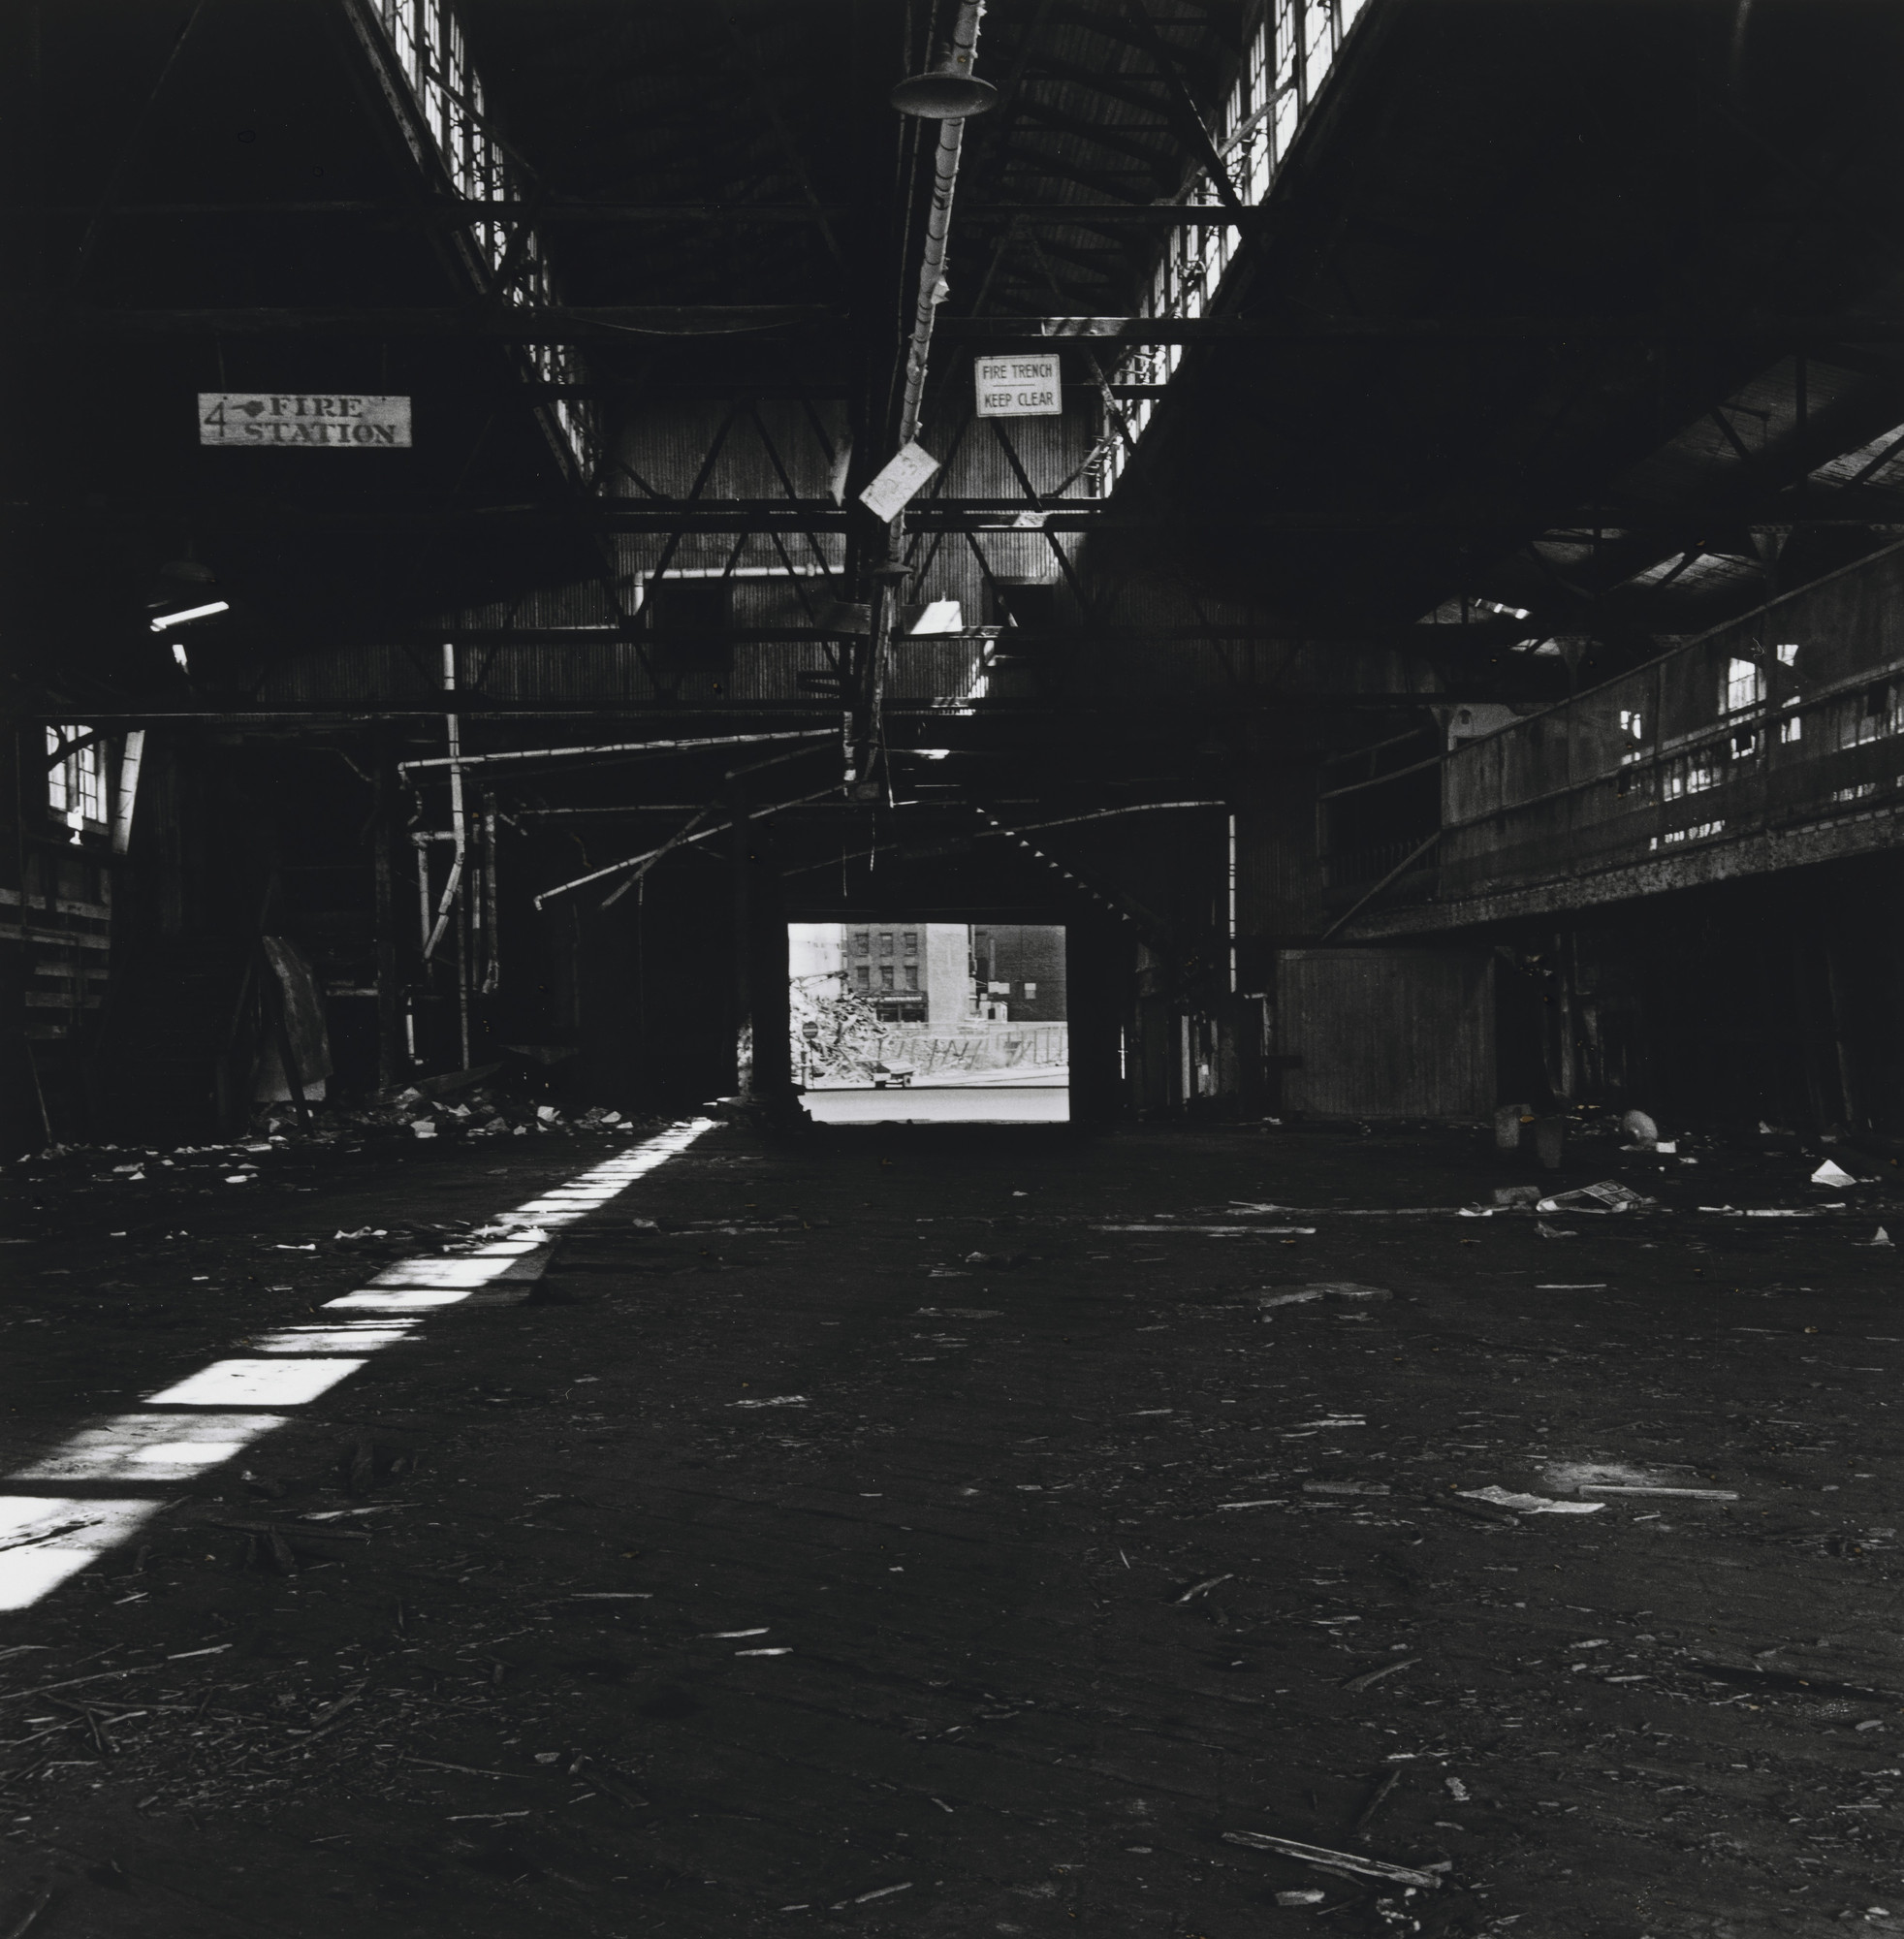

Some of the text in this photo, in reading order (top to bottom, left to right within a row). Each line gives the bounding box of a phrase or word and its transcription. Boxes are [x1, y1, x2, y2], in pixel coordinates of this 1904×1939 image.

[982, 364, 1053, 379] FIRE TRENCH
[984, 392, 1054, 408] KEEP CLEAR
[204, 397, 363, 437] 4 FIRE
[244, 422, 397, 444] STATION
